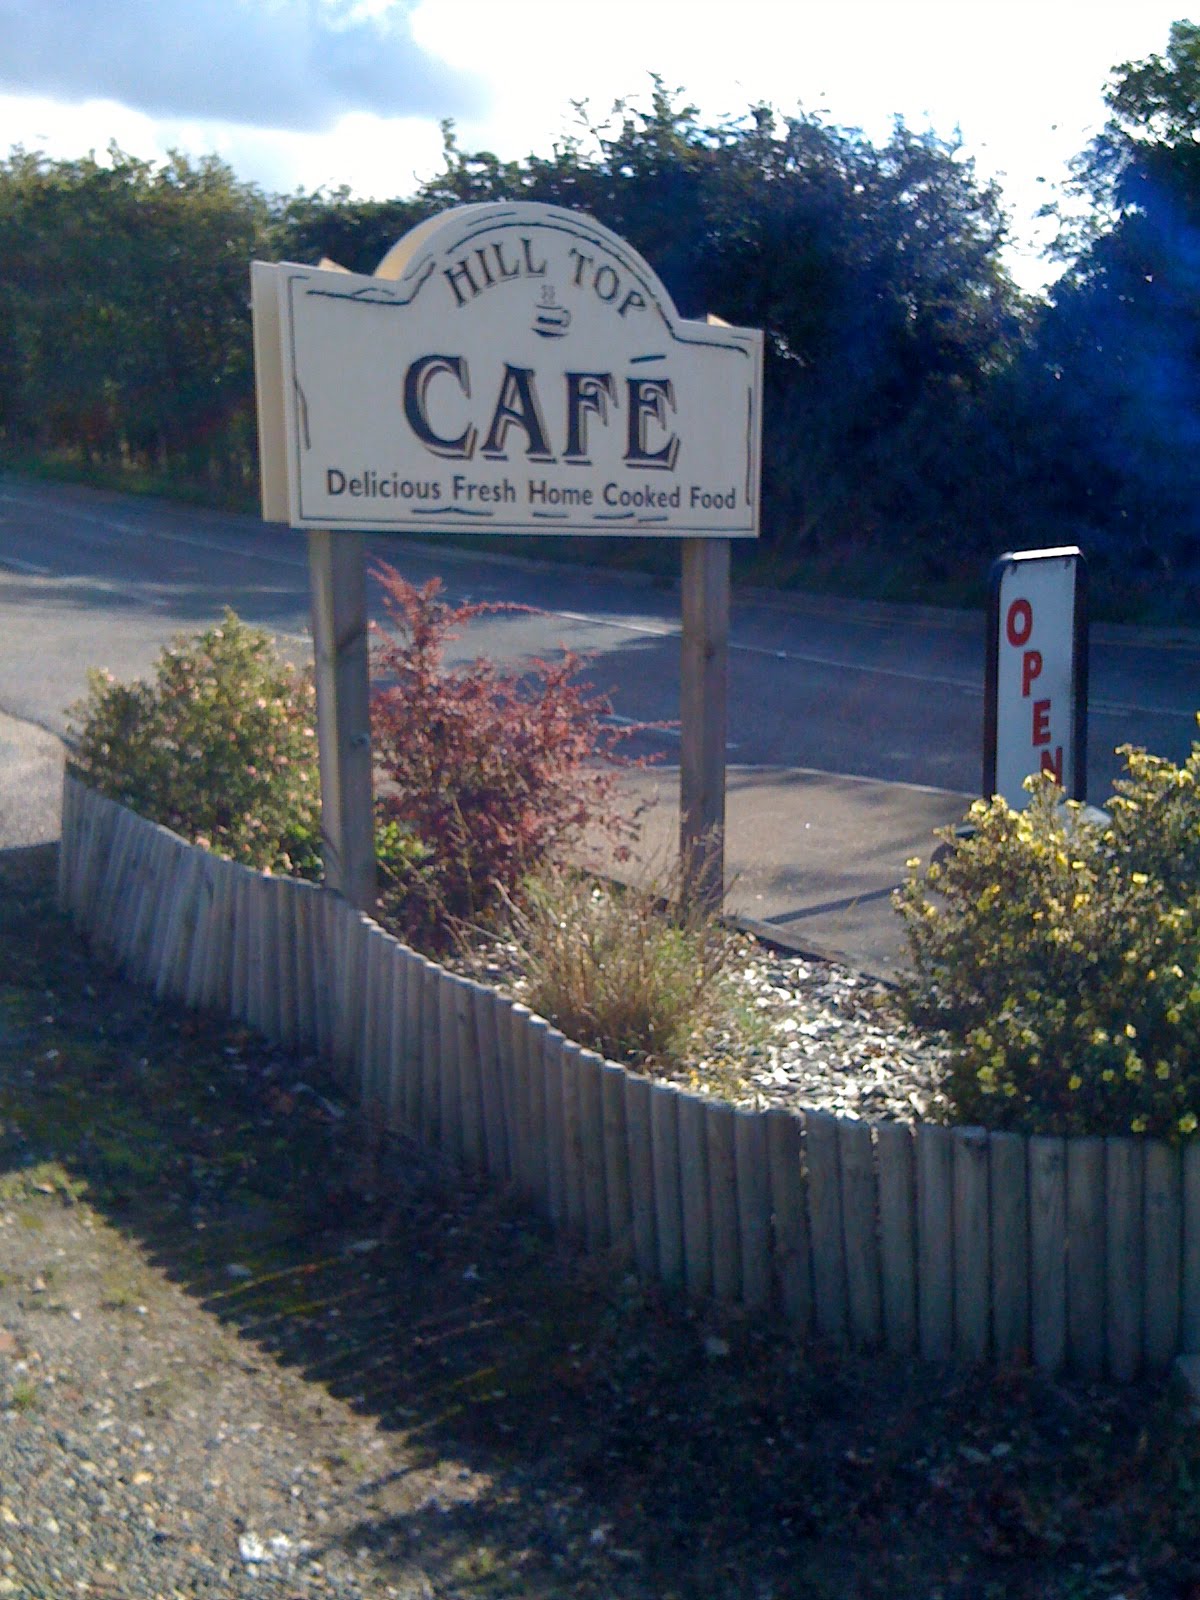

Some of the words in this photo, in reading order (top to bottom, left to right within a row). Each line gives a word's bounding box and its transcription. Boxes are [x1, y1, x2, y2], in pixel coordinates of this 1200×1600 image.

[443, 238, 546, 307] HILL
[569, 247, 646, 318] TOP
[403, 353, 680, 471] CAFÉ
[326, 469, 441, 500] Delicious
[453, 475, 516, 504] Fresh
[528, 480, 593, 506] Home
[603, 482, 681, 509] Cooked
[690, 486, 736, 511] Food
[1006, 597, 1063, 787] OPEN
